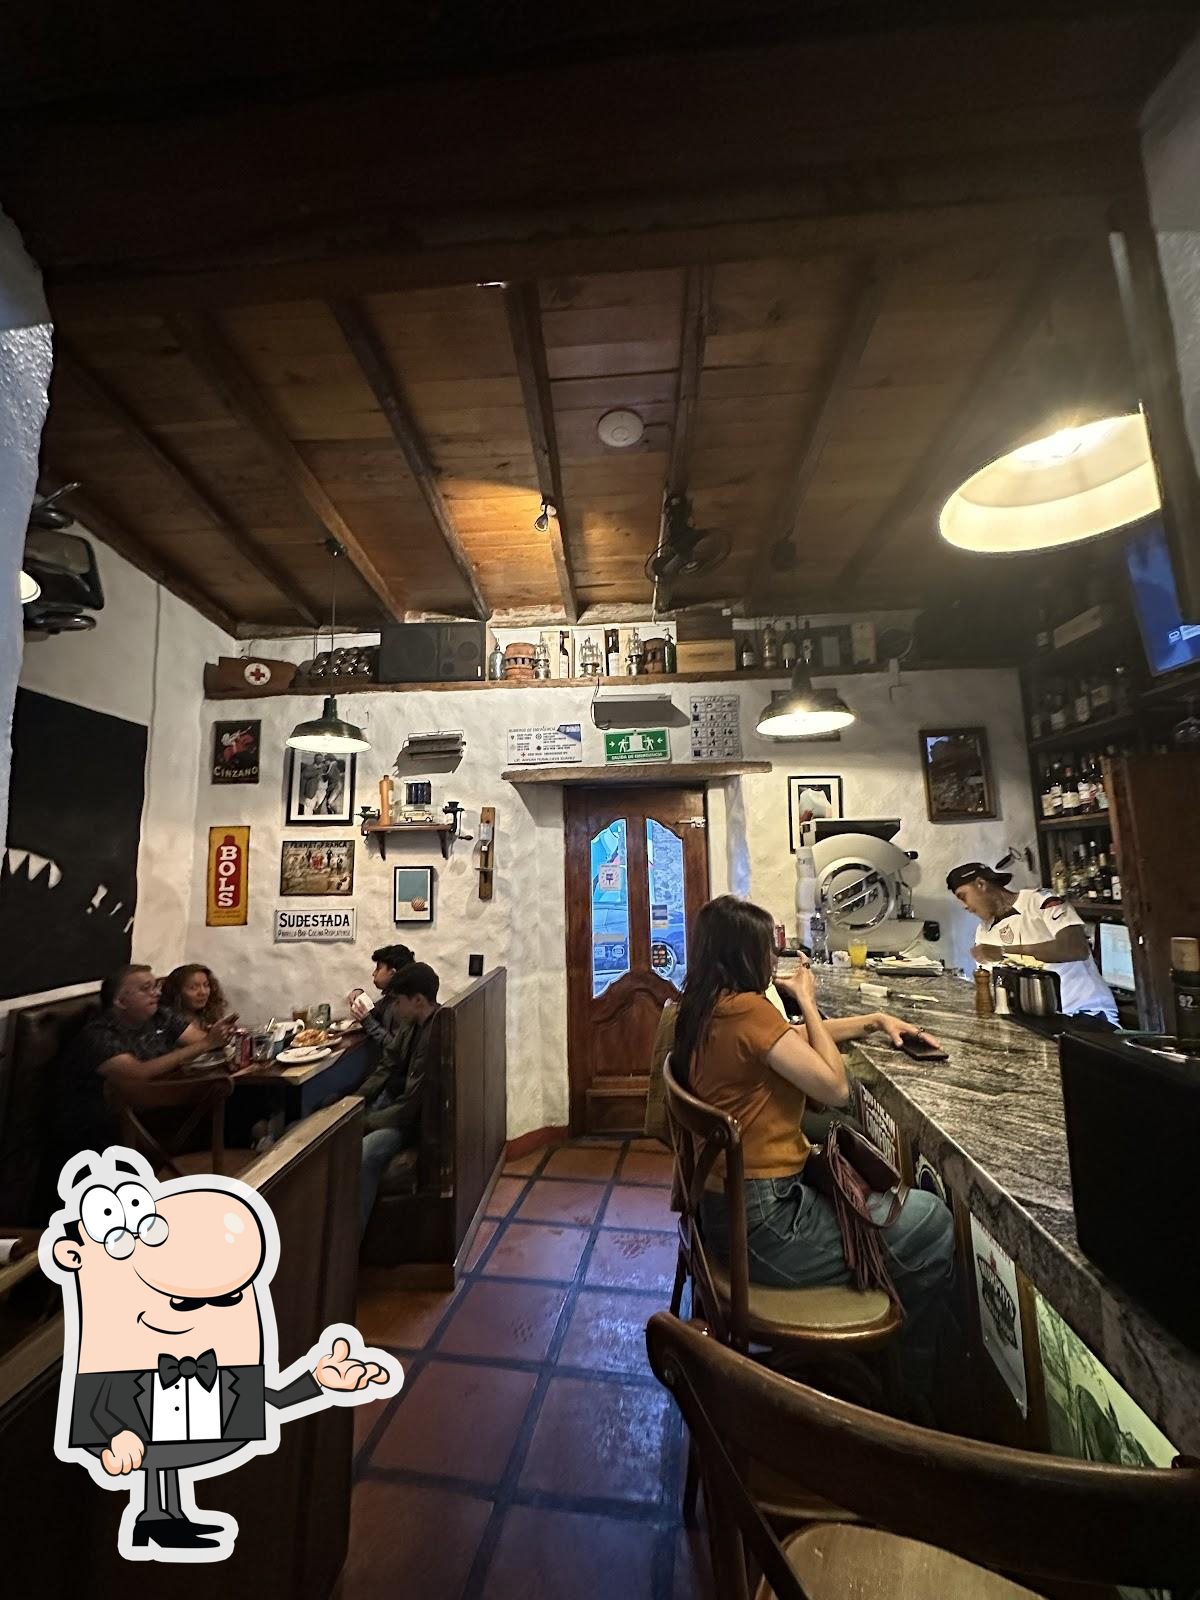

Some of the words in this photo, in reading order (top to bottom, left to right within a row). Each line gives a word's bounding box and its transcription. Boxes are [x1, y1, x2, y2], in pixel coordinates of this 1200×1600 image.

[213, 766, 258, 778] CINZANO
[218, 845, 238, 907] BOLS
[279, 912, 350, 928] SUDESTADA
